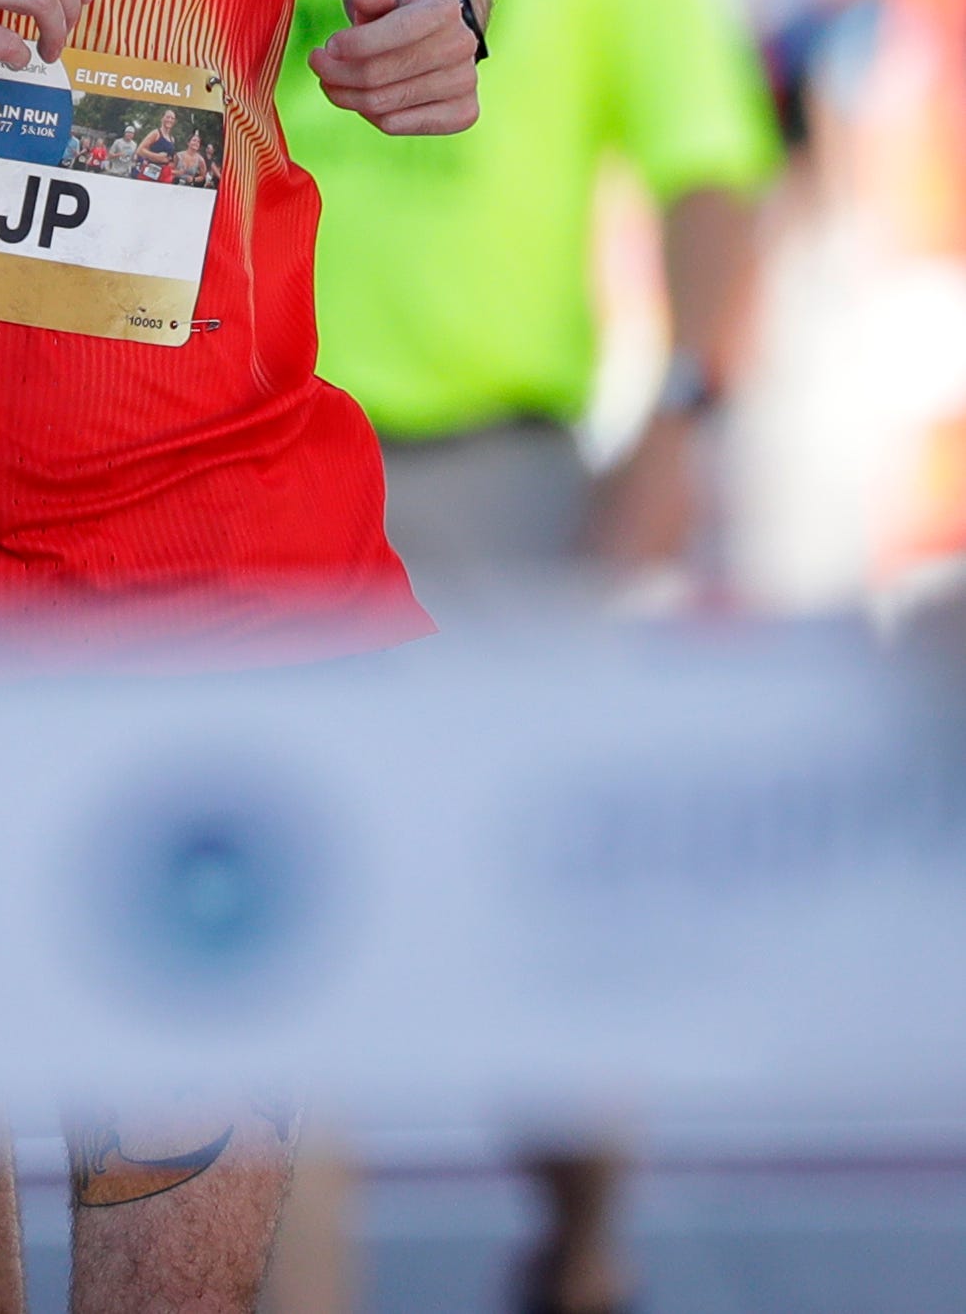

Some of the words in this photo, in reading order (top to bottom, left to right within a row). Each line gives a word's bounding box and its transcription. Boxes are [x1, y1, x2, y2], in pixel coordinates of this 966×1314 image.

[75, 68, 117, 88] ELITE
[121, 75, 181, 97] CORRAL
[184, 84, 192, 98] 1
[23, 108, 59, 126] RUN
[129, 315, 163, 329] 10003
